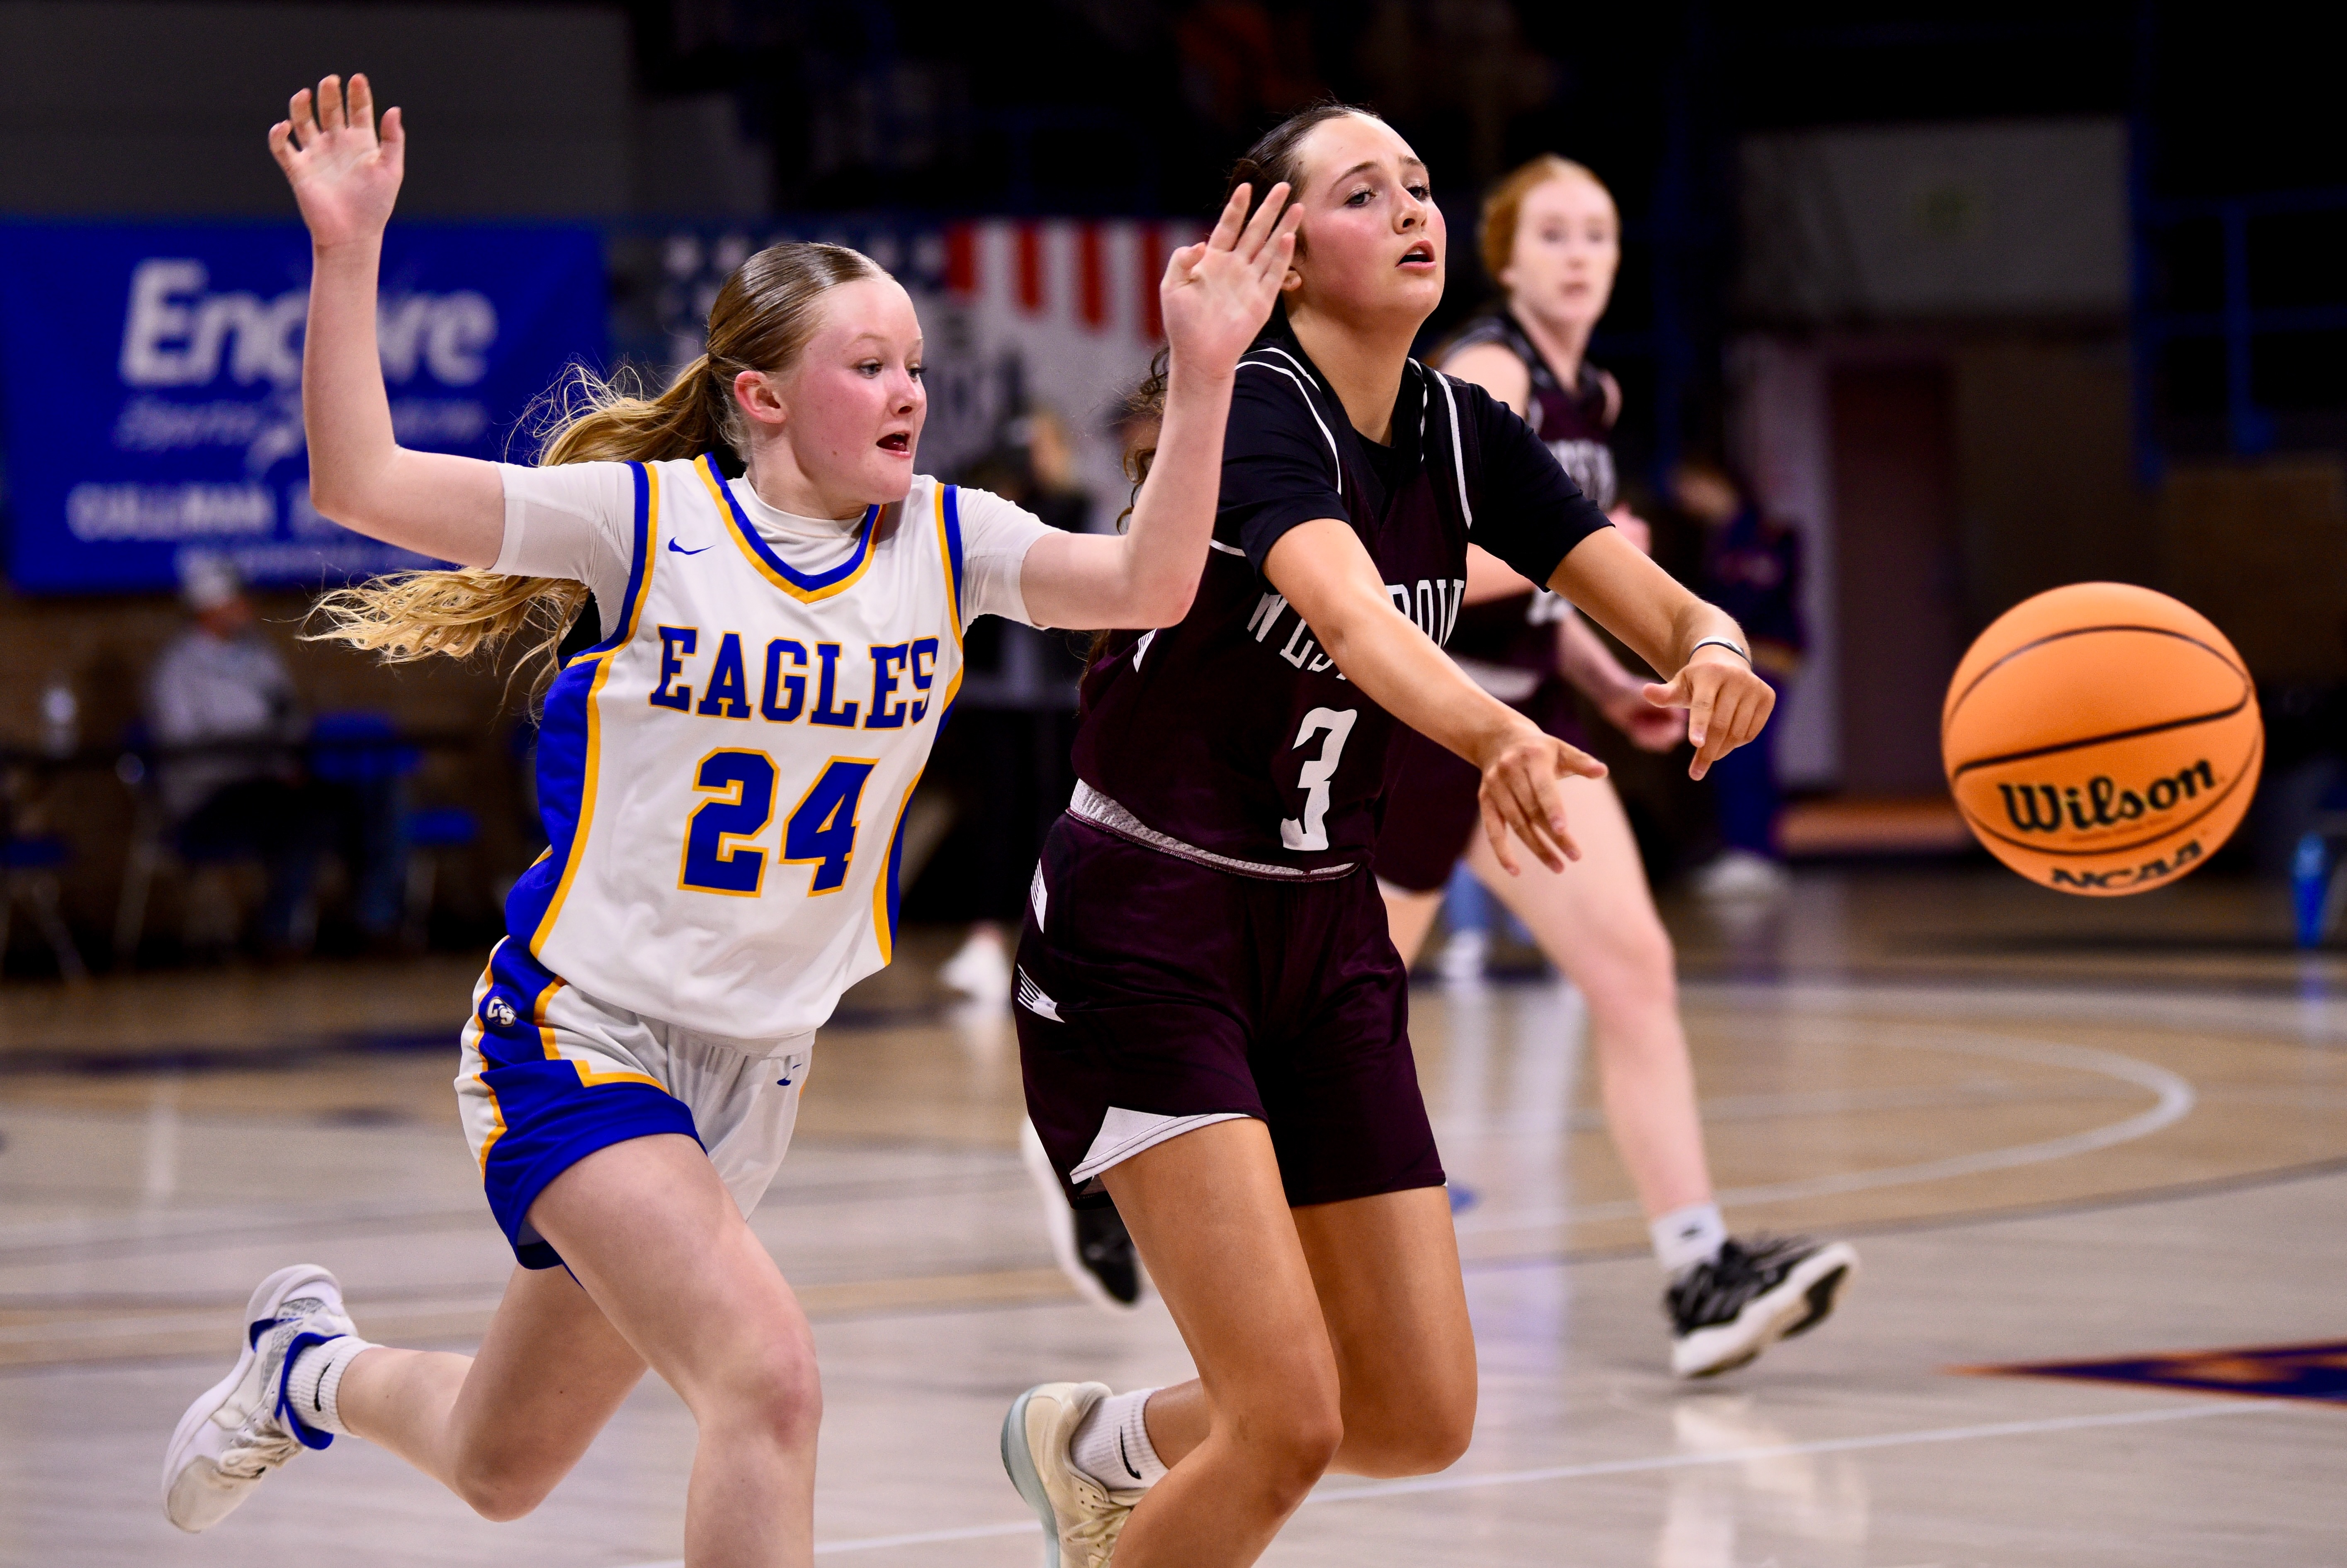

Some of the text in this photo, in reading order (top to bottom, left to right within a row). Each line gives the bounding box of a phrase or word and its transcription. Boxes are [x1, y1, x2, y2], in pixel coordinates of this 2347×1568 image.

[118, 258, 499, 386] Encre
[649, 624, 939, 730] EAGLES
[677, 746, 880, 898] 24
[1280, 707, 1358, 851] 3
[1998, 759, 2215, 832] Wilson
[2053, 840, 2202, 887] NCAA
